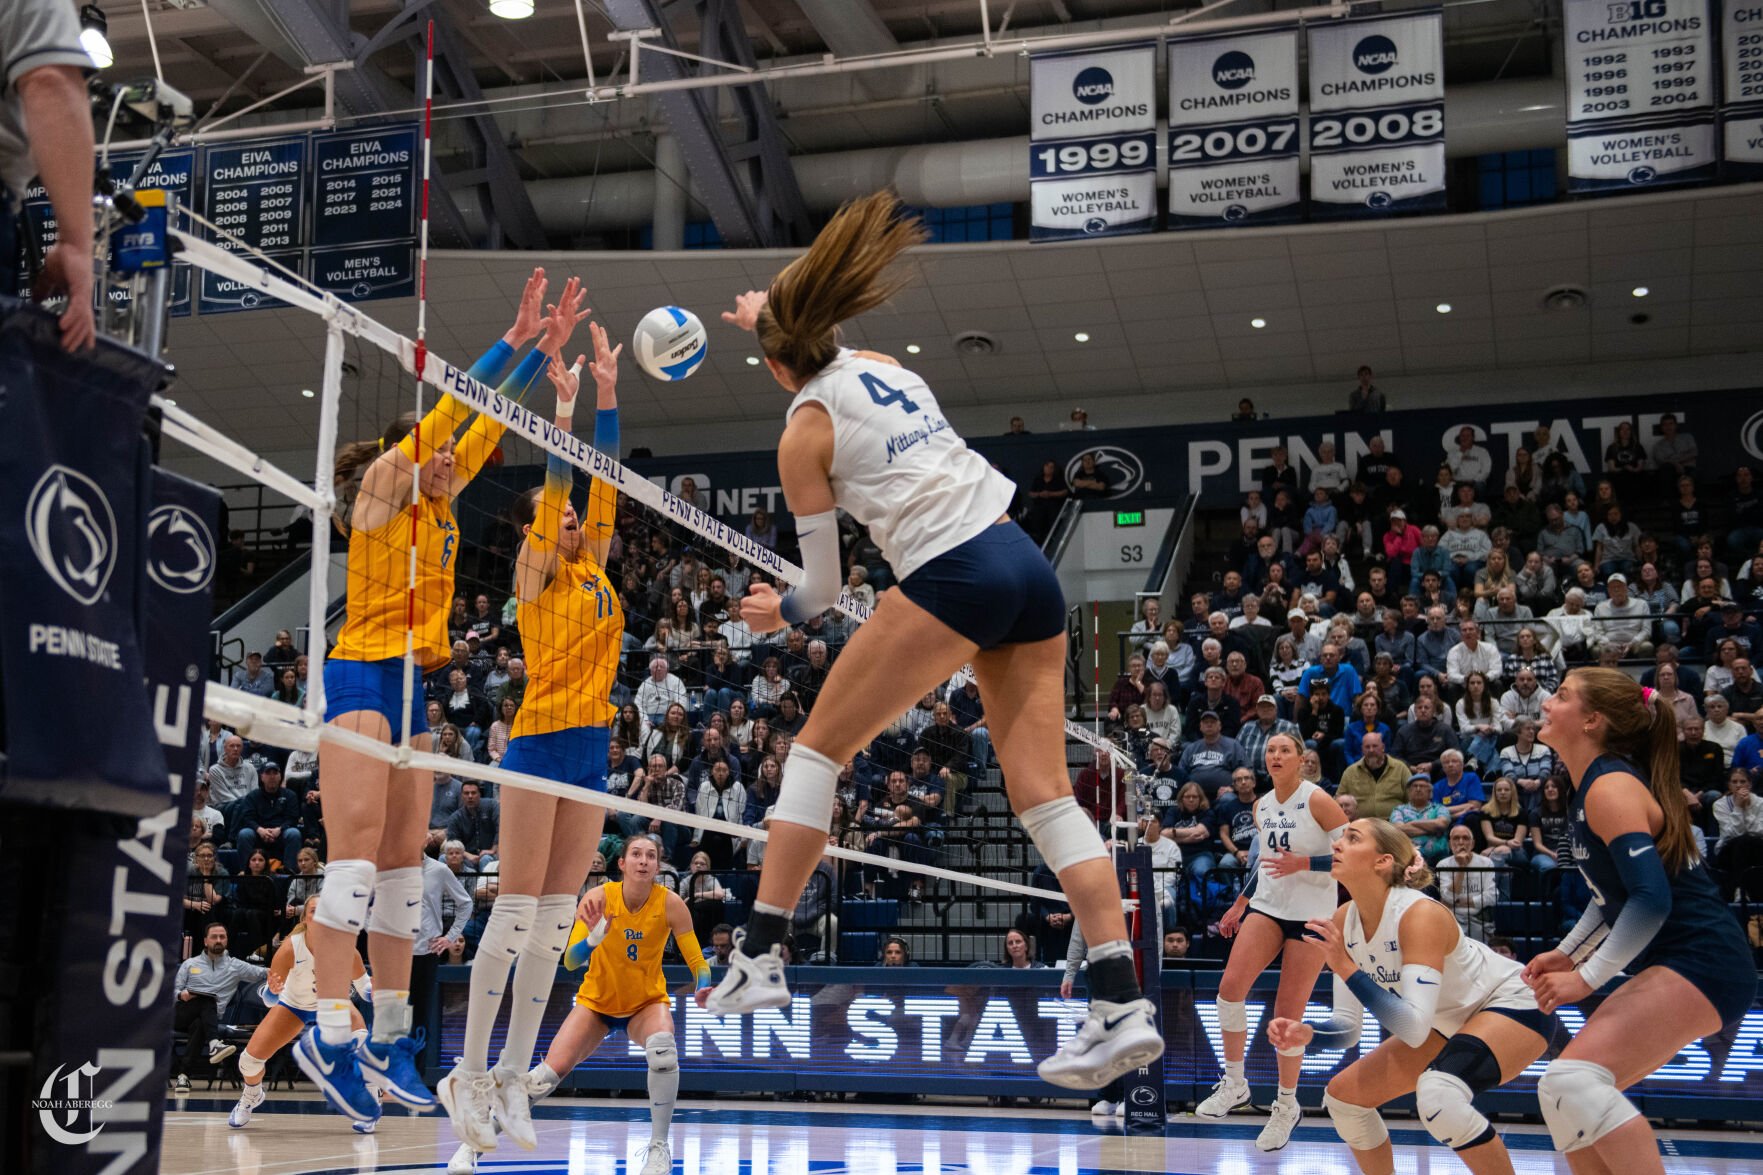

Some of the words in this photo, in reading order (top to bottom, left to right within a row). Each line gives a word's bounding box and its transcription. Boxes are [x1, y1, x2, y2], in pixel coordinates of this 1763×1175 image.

[1576, 16, 1701, 44] CHAMPIONS
[1357, 52, 1397, 66] NCAA
[1583, 53, 1627, 67] 1992
[1651, 45, 1696, 59] 1993
[1216, 68, 1255, 82] NCAA
[1583, 69, 1628, 82] 1996
[1652, 60, 1696, 75] 1997
[1076, 83, 1113, 97] NCAA
[1321, 73, 1436, 96] CHAMPIONS
[1584, 84, 1628, 98] 1998
[1653, 76, 1696, 91] 1999
[1180, 88, 1291, 111] CHAMPIONS
[1582, 100, 1630, 113] 2003
[1650, 92, 1699, 106] 2004
[1041, 103, 1148, 125] CHAMPIONS
[1312, 109, 1443, 146] 2008
[350, 140, 382, 154] EIVA
[1172, 123, 1296, 160] 2007
[1602, 133, 1681, 151] WOMEN'S
[241, 151, 272, 165] EIVA
[322, 151, 409, 171] CHAMPIONS
[1038, 140, 1148, 173] 1999
[1590, 146, 1694, 166] VOLLEYBALL
[213, 161, 298, 180] CHAMPIONS
[1343, 161, 1415, 176] WOMEN'S
[111, 172, 188, 190] HMPIONS
[326, 180, 356, 190] 2014
[372, 174, 402, 186] 2015
[1200, 174, 1270, 190] WOMEN'S
[1332, 173, 1426, 190] VOLLEYBALL
[216, 189, 248, 200] 2004
[260, 185, 293, 196] 2005
[326, 192, 356, 203] 2017
[371, 187, 401, 198] 2021
[1061, 187, 1129, 203] WOMEN'S
[1190, 186, 1281, 203] VOLLEYBALL
[215, 202, 248, 212] 2006
[260, 198, 292, 209] 2007
[324, 204, 357, 216] 2023
[370, 200, 403, 211] 2024
[1051, 200, 1139, 216] VOLLEYBALL
[215, 215, 247, 225] 2008
[259, 210, 292, 221] 2009
[262, 224, 288, 234] 2011
[260, 236, 289, 247] 2013
[344, 257, 381, 269] MEN'S
[326, 266, 398, 282] VOLLEYBALL
[858, 371, 920, 414] 4
[444, 364, 489, 407] PENN
[493, 392, 538, 434] STATE
[543, 420, 625, 484] VOLLEYBALL
[886, 431, 929, 464] Nittany
[1117, 511, 1142, 526] EXIT
[662, 490, 690, 522] PENN
[693, 506, 725, 539] STATE
[727, 527, 783, 574] VOLLEYBALL
[441, 534, 455, 569] 6
[1121, 545, 1143, 562] S3
[595, 585, 613, 620] 11
[30, 624, 87, 659] PENN
[86, 634, 122, 670] STATE
[1279, 818, 1296, 829] State
[103, 683, 191, 1009] STAE
[1268, 831, 1291, 852] 44
[624, 928, 643, 941] Pitt
[626, 943, 639, 962] 8
[1376, 965, 1401, 983] State
[844, 995, 1090, 1064] STAT
